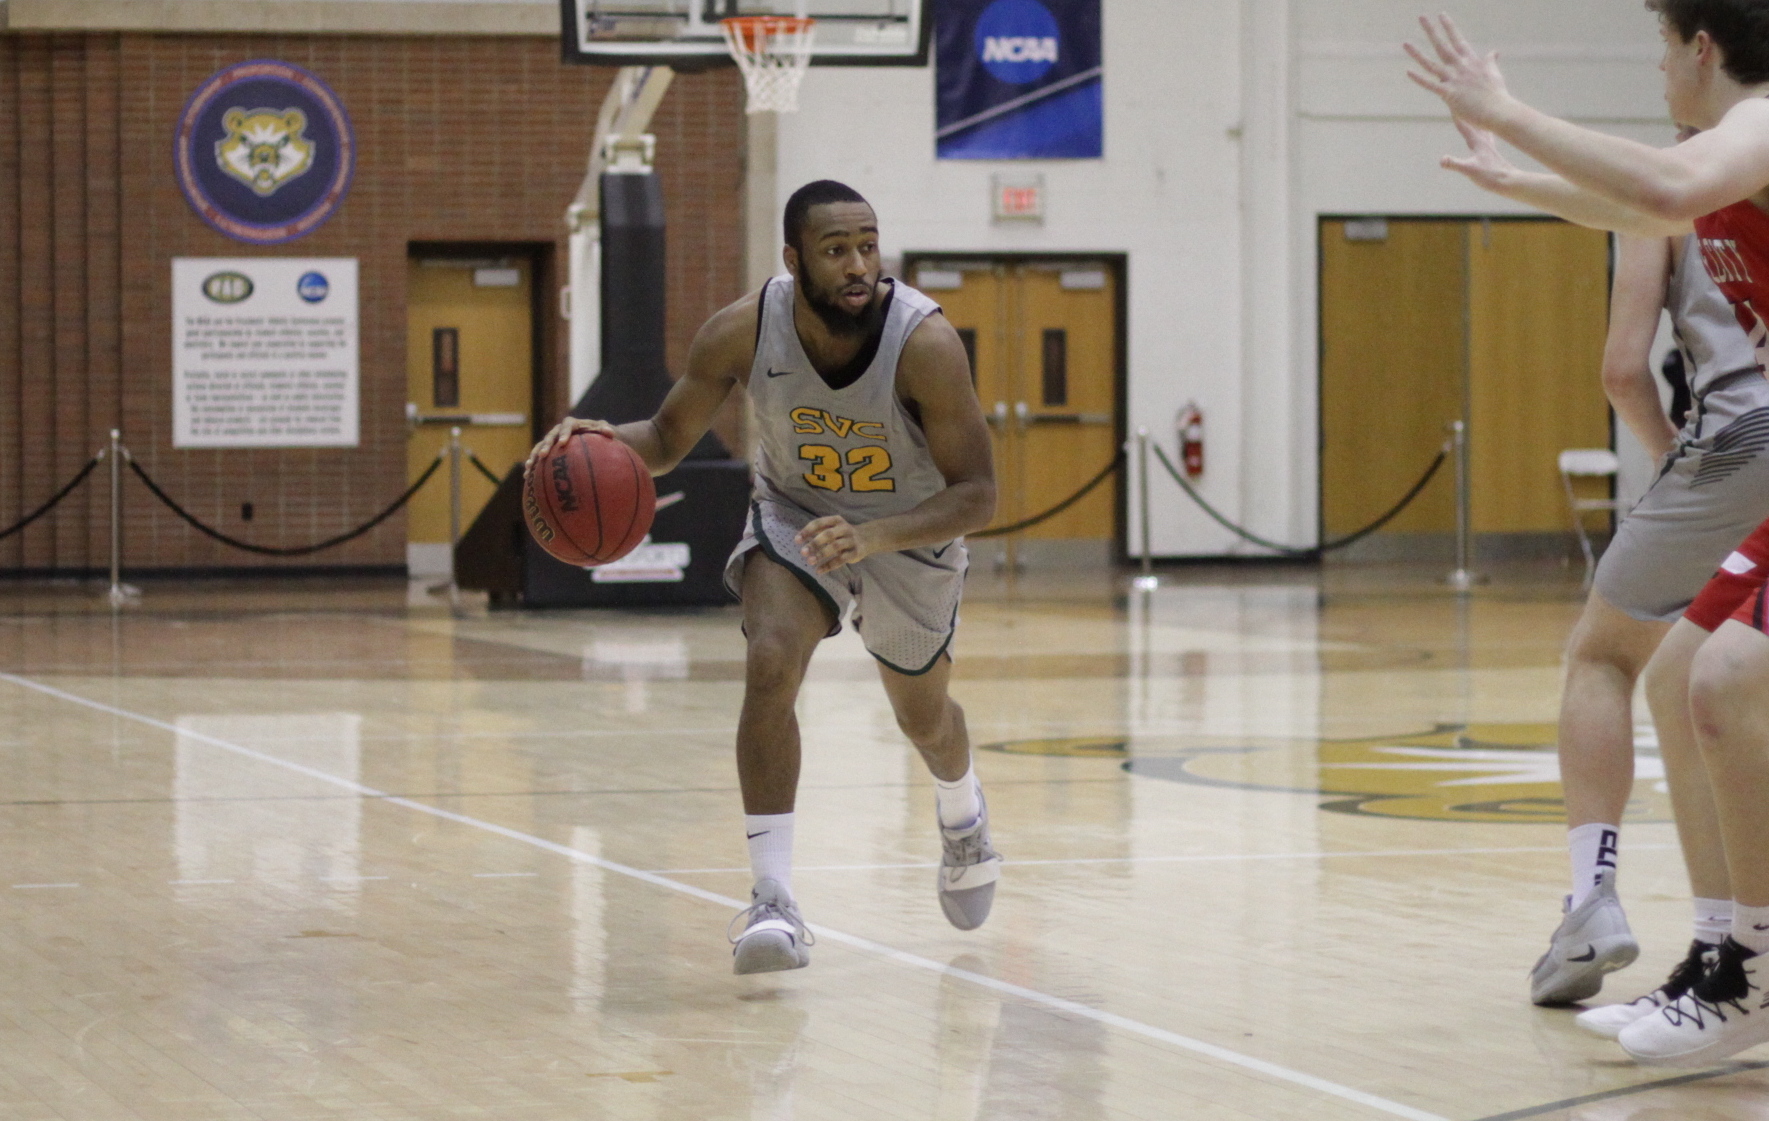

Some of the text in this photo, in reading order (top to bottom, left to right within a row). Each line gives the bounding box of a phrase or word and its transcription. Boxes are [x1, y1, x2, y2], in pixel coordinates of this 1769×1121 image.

[982, 36, 1059, 63] NCAA
[790, 406, 887, 441] SVC
[552, 453, 578, 513] NCAA
[798, 443, 896, 493] 32
